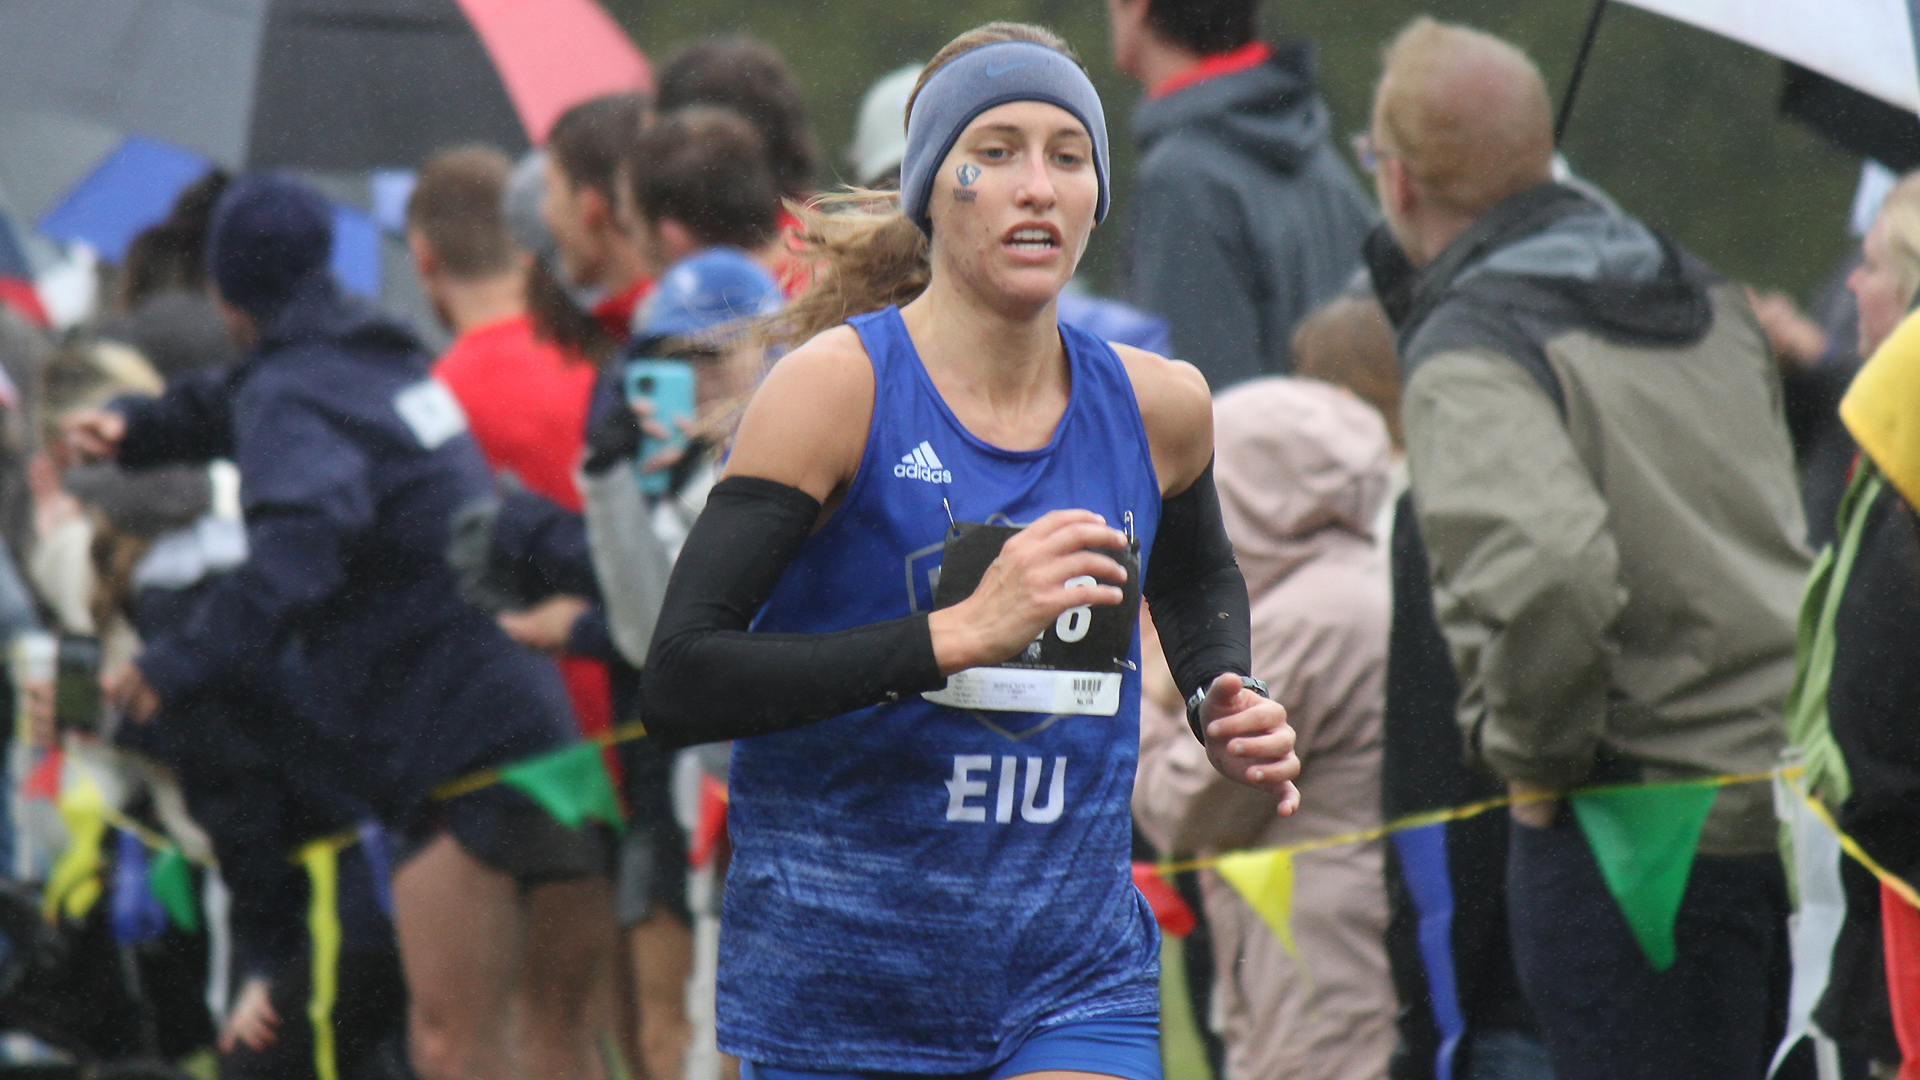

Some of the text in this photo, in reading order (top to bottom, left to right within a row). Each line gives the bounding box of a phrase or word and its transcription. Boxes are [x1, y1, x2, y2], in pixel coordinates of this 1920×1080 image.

[893, 463, 952, 484] adidas
[1035, 574, 1098, 643] 8
[944, 754, 1068, 825] EIU
